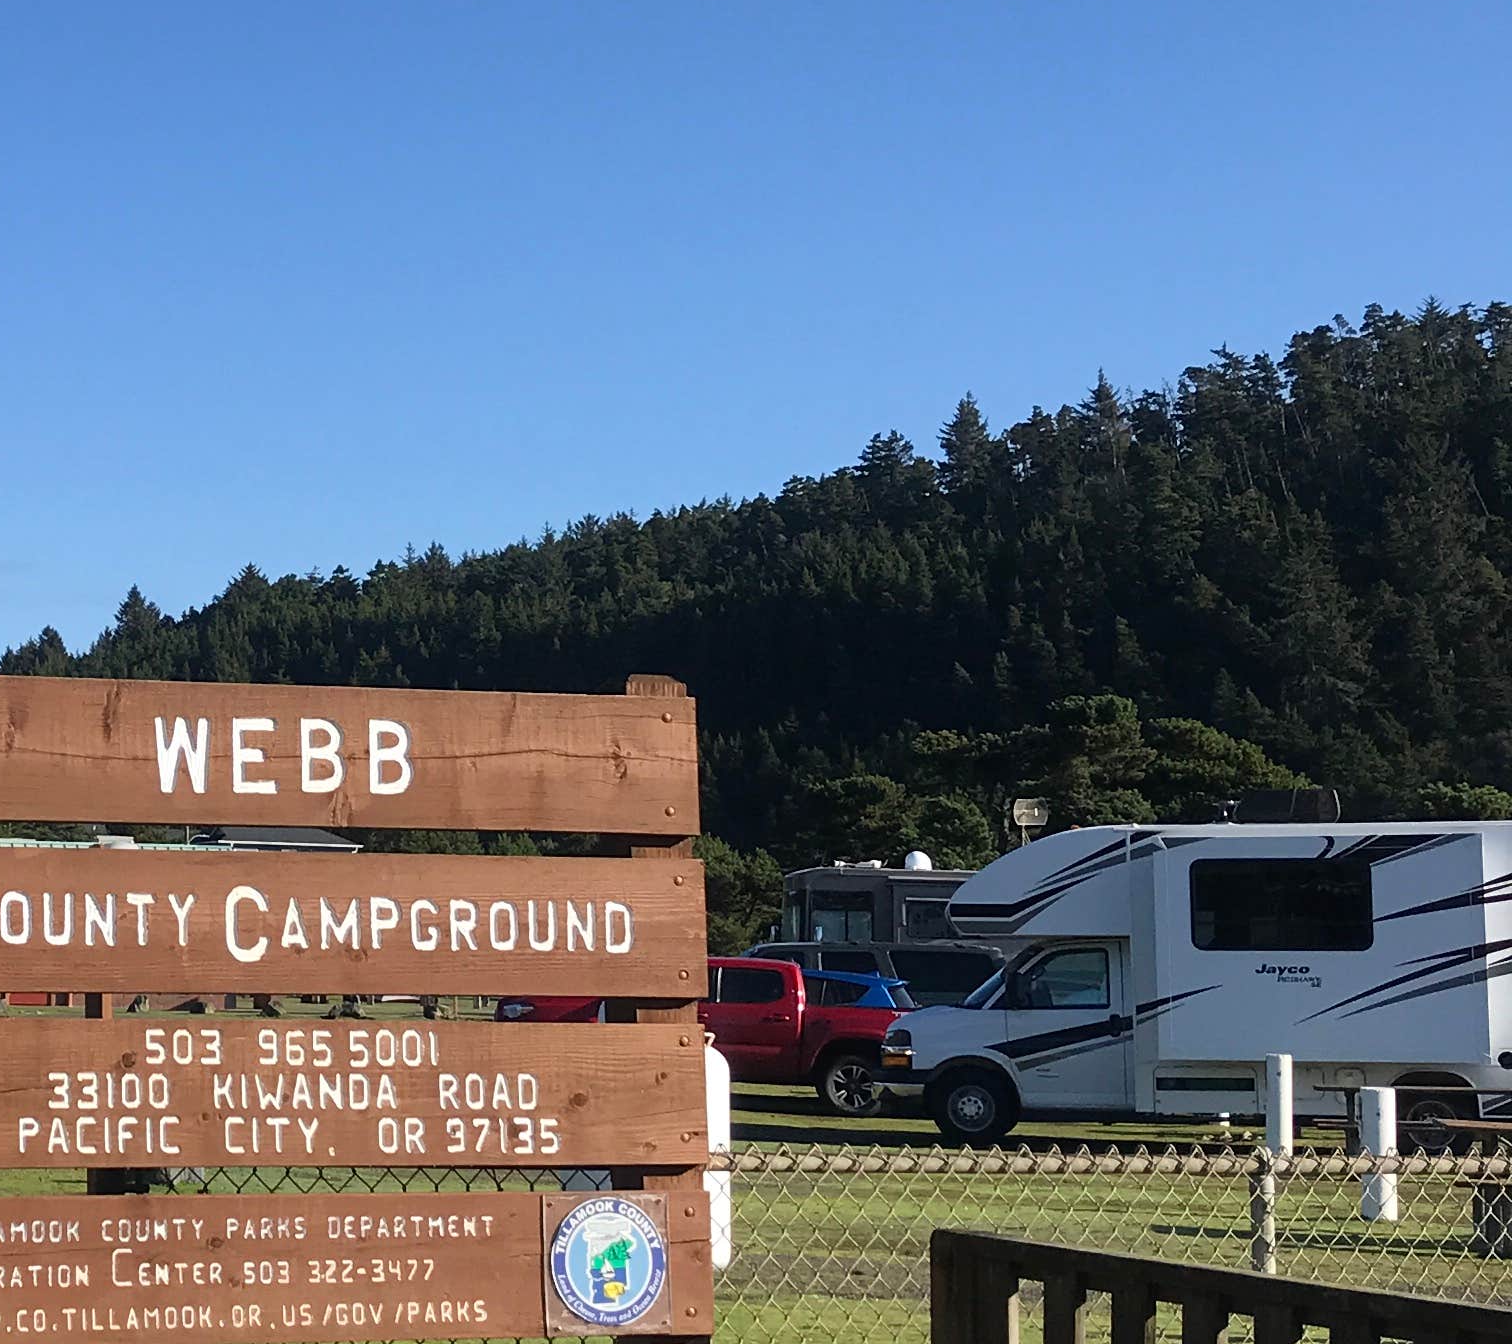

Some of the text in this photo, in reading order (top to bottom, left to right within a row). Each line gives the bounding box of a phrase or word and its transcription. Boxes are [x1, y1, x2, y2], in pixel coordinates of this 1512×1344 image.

[155, 717, 412, 794] WEBB
[225, 885, 635, 962] CAMPGROUND
[1255, 964, 1310, 976] Jayco
[144, 1028, 439, 1068] 503 965 5001
[47, 1071, 538, 1110] 33100 KIWANDA ROAD
[18, 1116, 181, 1154] PACIFIC
[377, 1117, 426, 1154] OR
[446, 1117, 561, 1154] 97135
[101, 1218, 204, 1243] COUNTY
[225, 1216, 307, 1240] PARKS
[327, 1215, 495, 1240] DEPARTMENT
[555, 1200, 661, 1255] TILLAMOOK COUNTY
[111, 1248, 223, 1287] CENTER
[243, 1260, 290, 1285] 503
[308, 1258, 435, 1284] 322-3477
